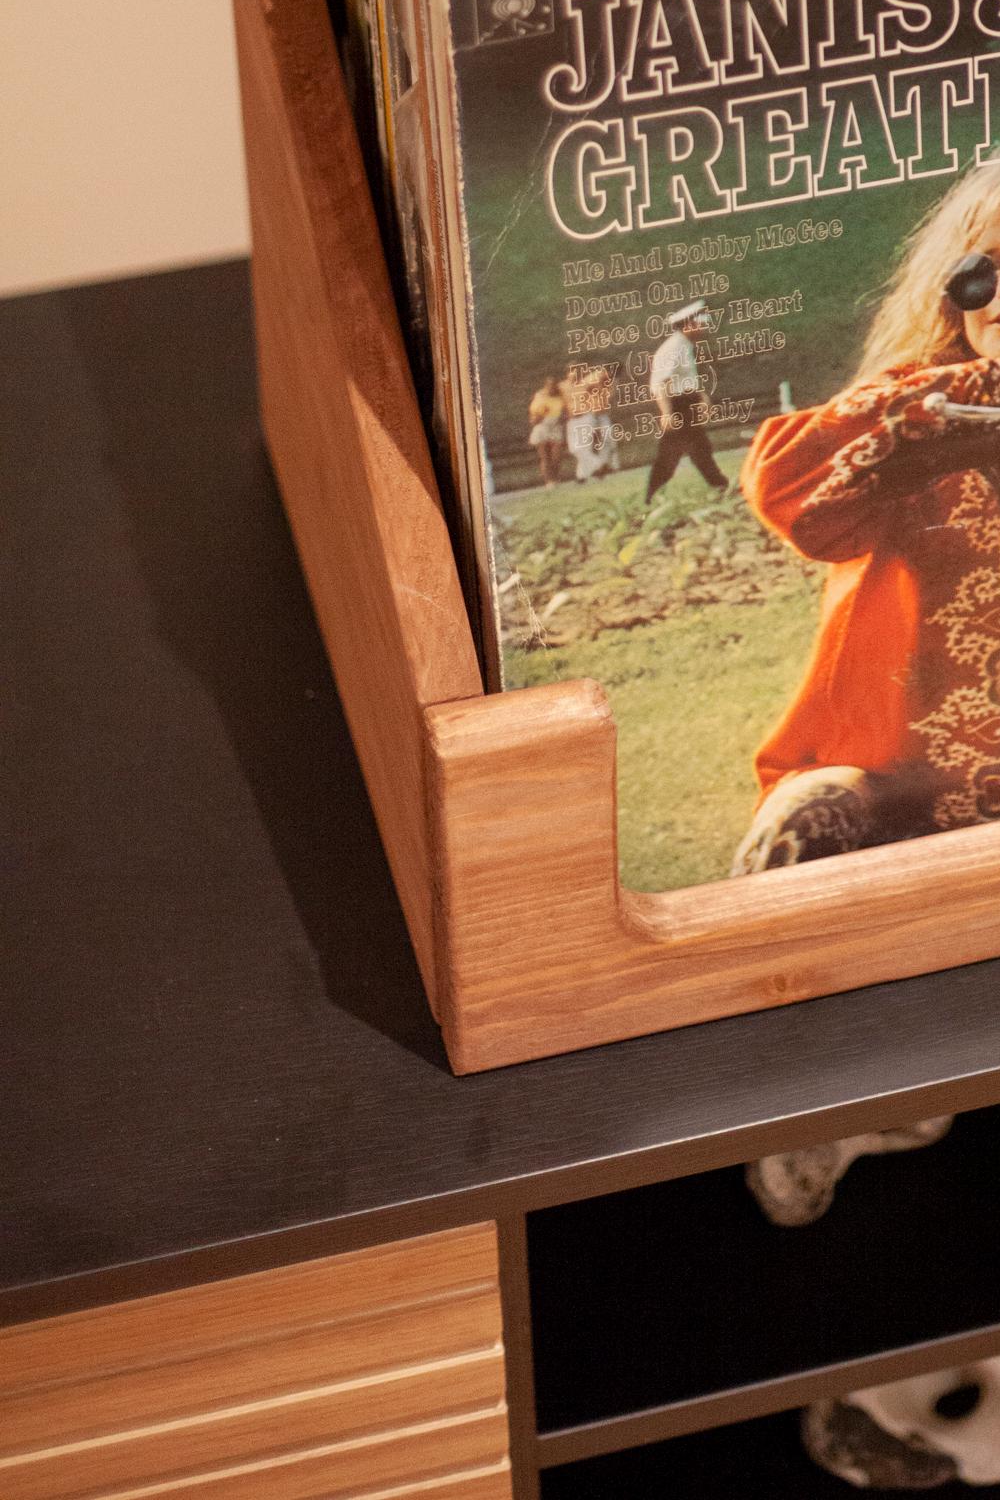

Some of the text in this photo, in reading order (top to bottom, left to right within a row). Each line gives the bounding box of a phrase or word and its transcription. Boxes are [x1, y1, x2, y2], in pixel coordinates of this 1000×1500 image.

[563, 218, 844, 286] Me And Bobby McGee
[565, 271, 730, 320] Down On Me
[567, 322, 640, 353] Piece
[729, 289, 803, 324] Heart
[569, 360, 620, 390] Try
[695, 340, 714, 365] A
[717, 329, 786, 360] Little
[572, 365, 718, 416] Bit Harder)
[635, 410, 684, 439] Bye
[690, 397, 755, 428] Baby
